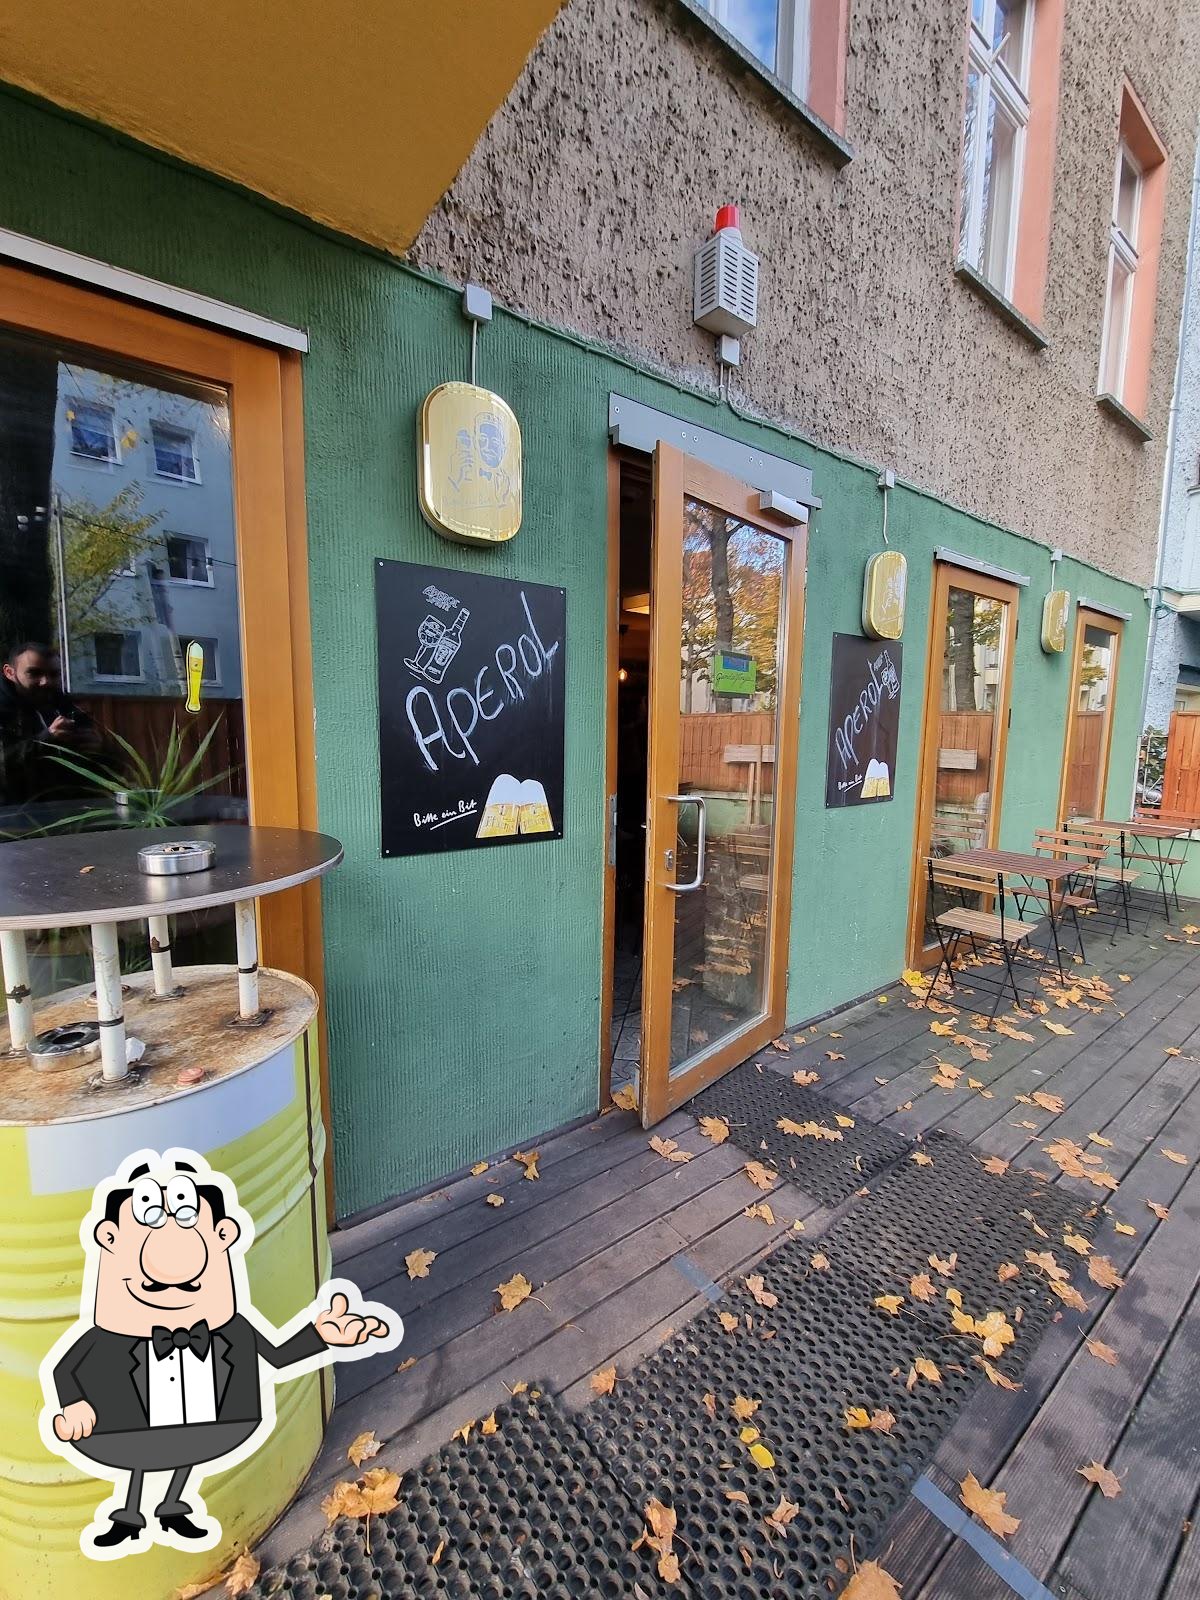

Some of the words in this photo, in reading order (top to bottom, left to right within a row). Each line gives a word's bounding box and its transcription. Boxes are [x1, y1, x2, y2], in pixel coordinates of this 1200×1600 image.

[405, 591, 558, 771] APEROL
[835, 658, 883, 770] APEROL
[413, 812, 438, 827] Bitte
[441, 809, 457, 818] ein
[458, 798, 477, 812] Bit
